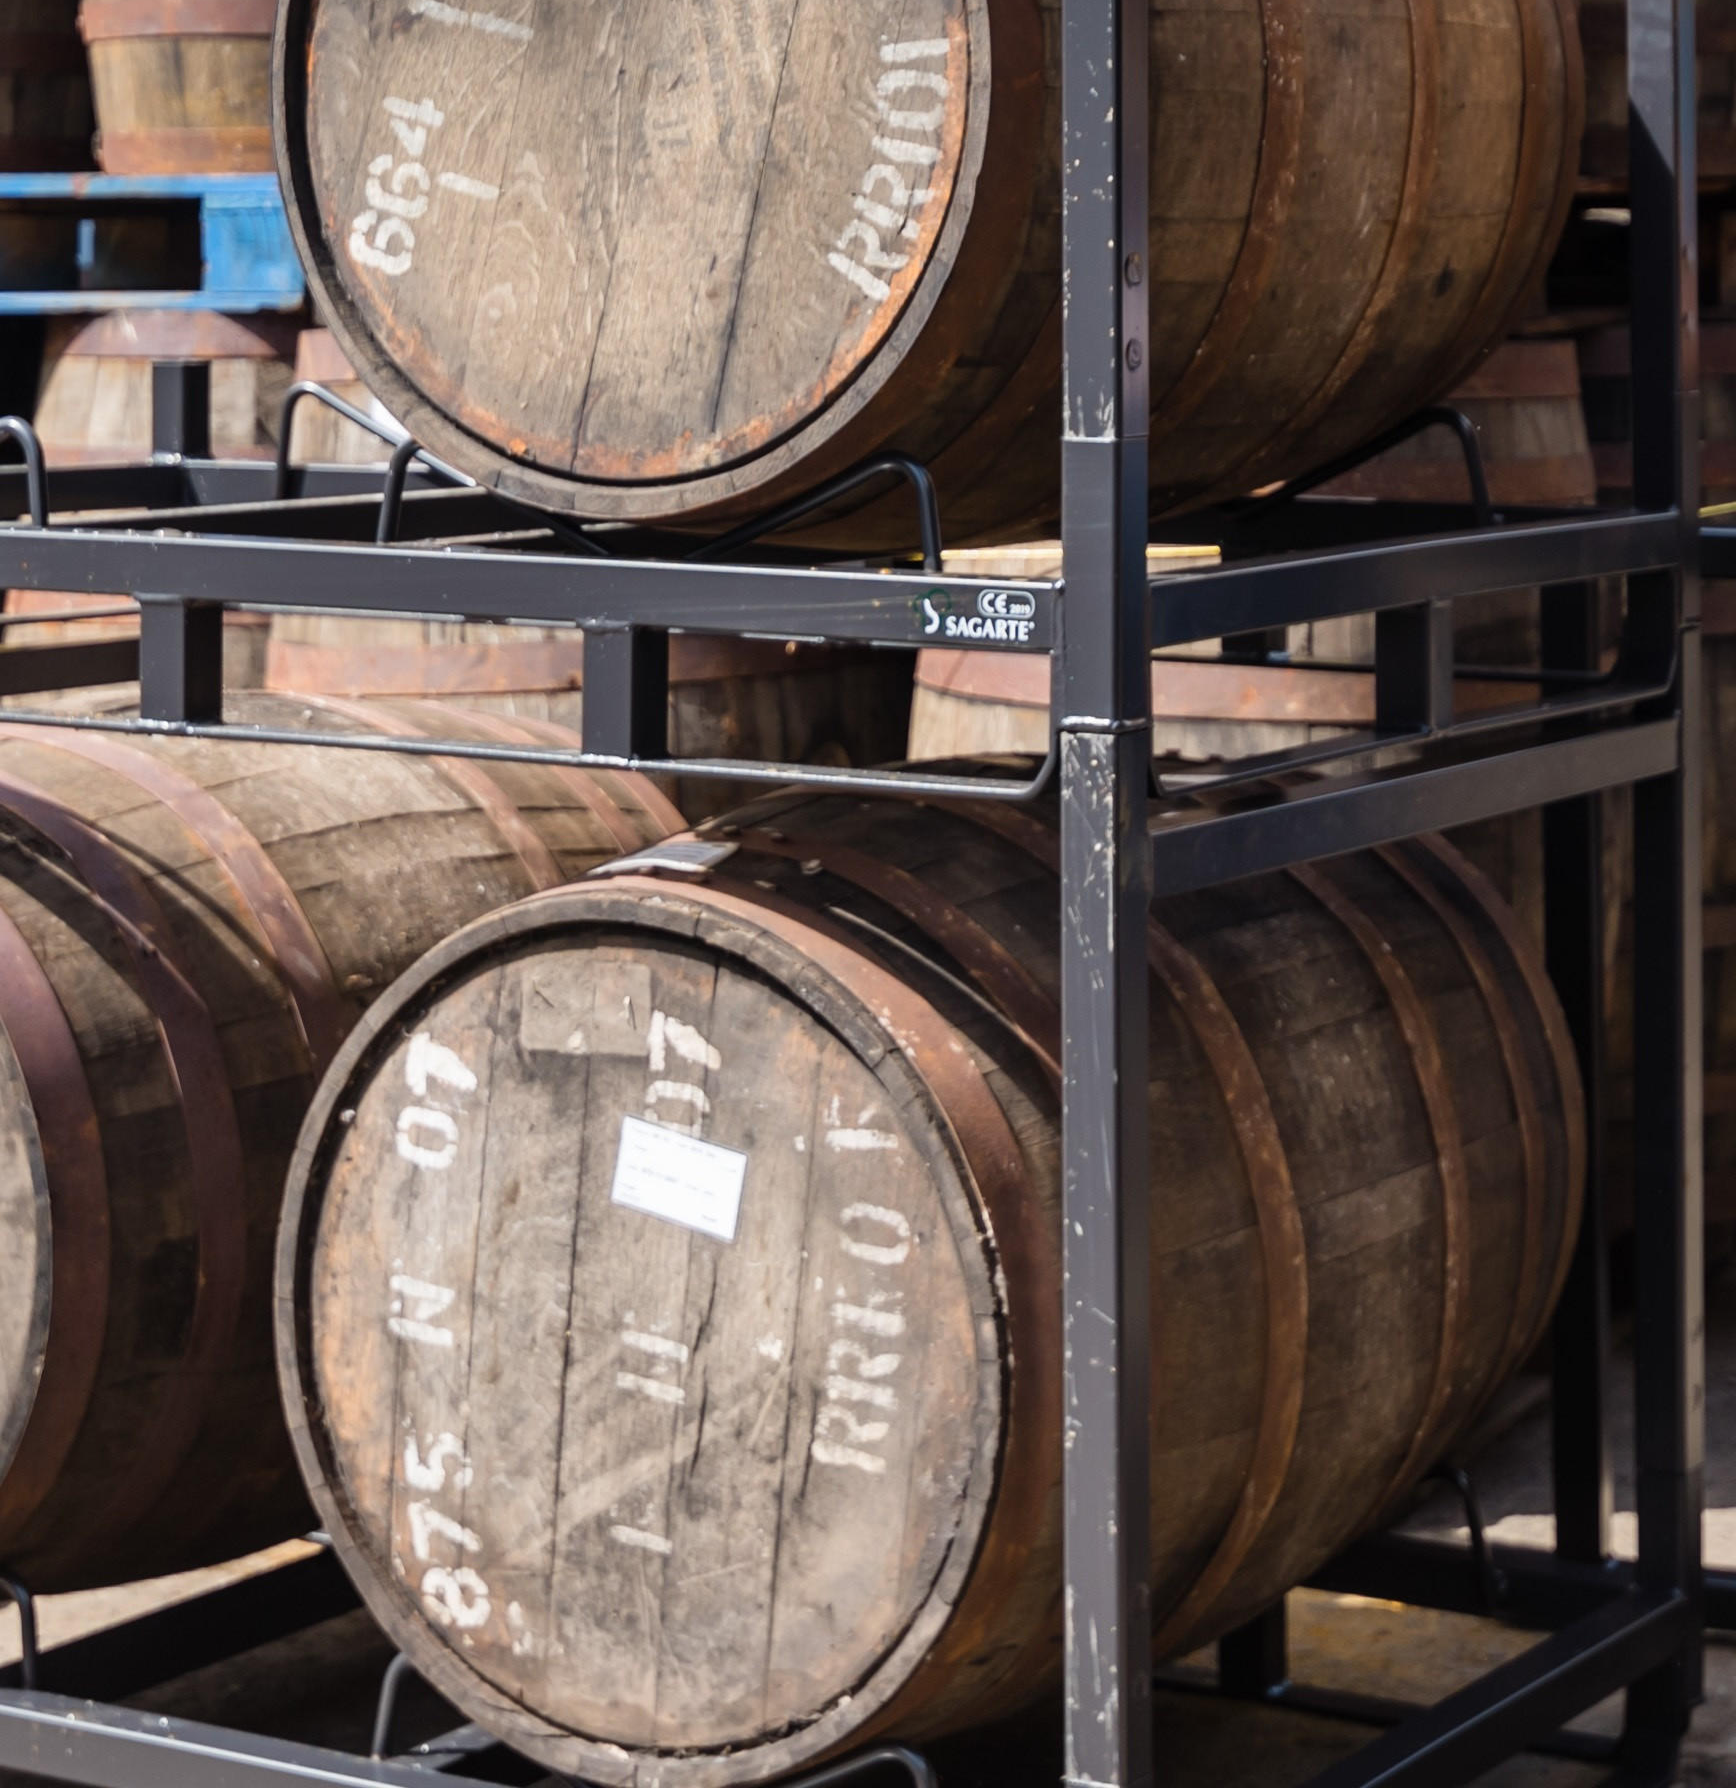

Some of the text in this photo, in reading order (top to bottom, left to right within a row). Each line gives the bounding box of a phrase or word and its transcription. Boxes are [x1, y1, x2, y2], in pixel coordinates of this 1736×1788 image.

[349, 94, 445, 276] 664
[945, 615, 1030, 642] SAGARTE
[403, 1430, 491, 1629] 875
